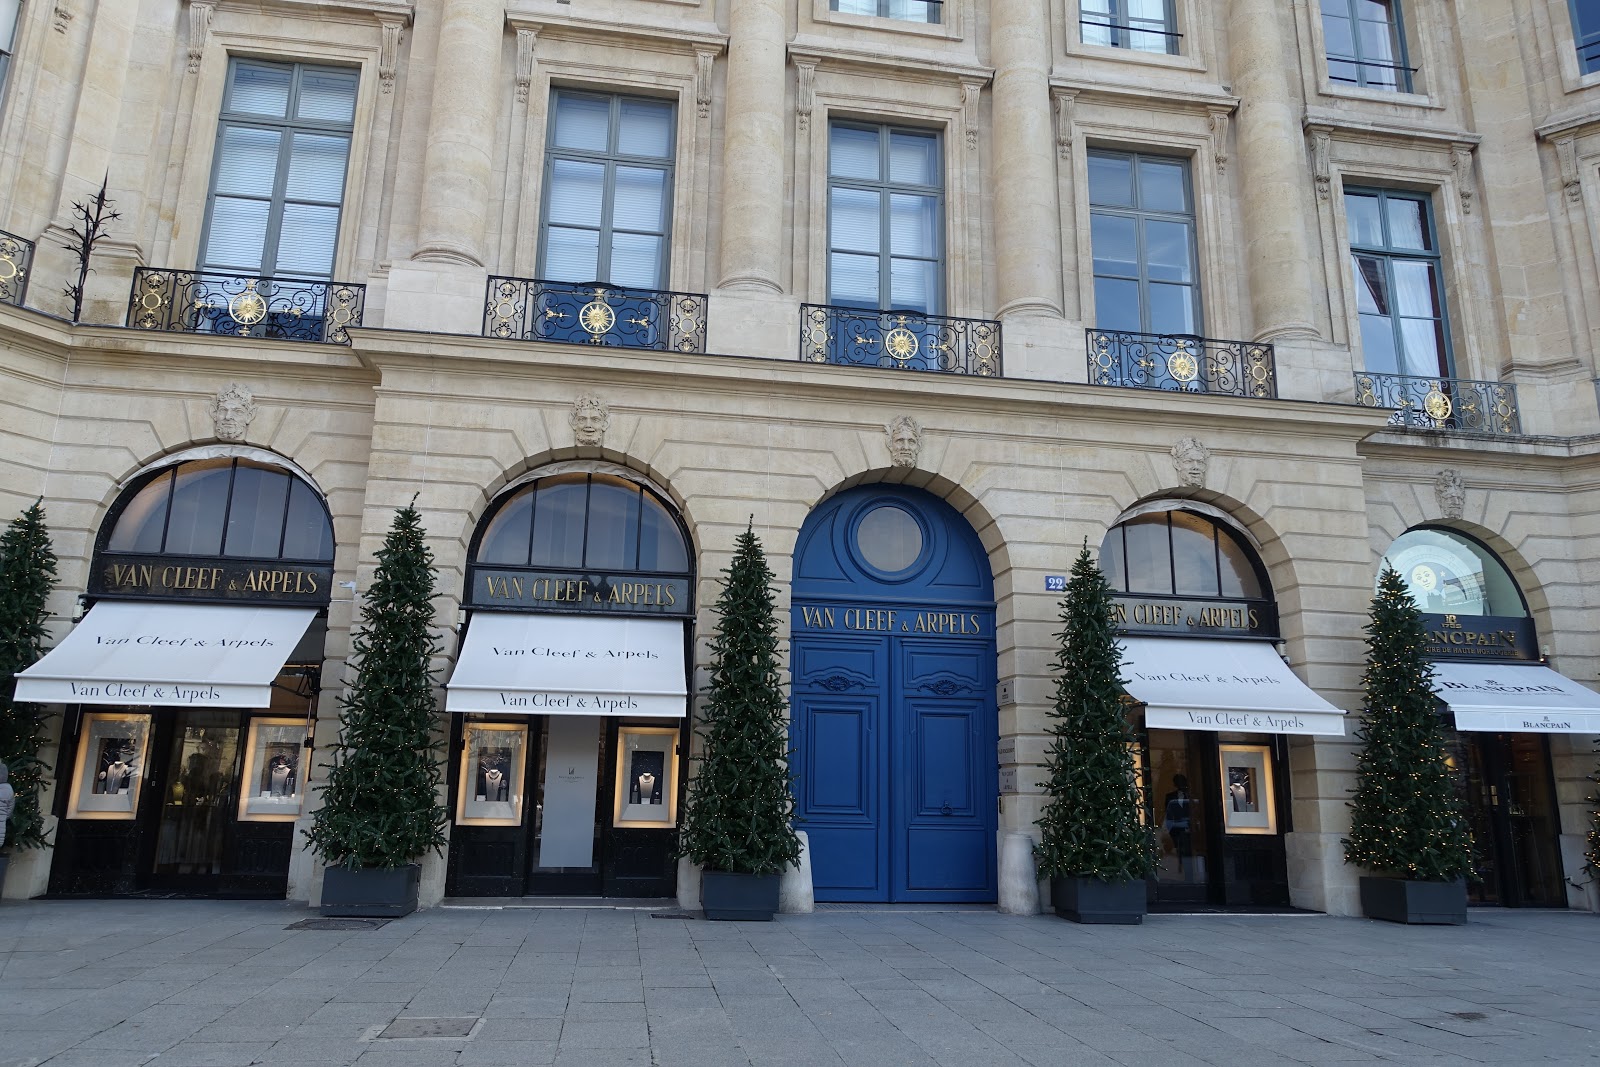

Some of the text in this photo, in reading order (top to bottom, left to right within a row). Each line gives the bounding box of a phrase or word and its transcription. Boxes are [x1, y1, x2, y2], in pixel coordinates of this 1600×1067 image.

[113, 564, 319, 594] VAN CLEEF & ARPELS
[1048, 578, 1064, 590] 22
[487, 576, 676, 607] VAN CLEEF & ARPELS
[801, 606, 981, 635] VAN CLEEF & ARPELS
[1107, 603, 1259, 629] AN CLEEF & ARPELS
[95, 635, 130, 646] Van
[136, 635, 194, 647] Cleef
[215, 637, 274, 649] Arpels
[493, 647, 525, 656] Van
[531, 647, 581, 658] Cleef
[602, 649, 659, 660] Arpels
[1135, 672, 1167, 682] Van
[1169, 672, 1211, 682] Cleef
[1232, 674, 1281, 686] Arpels
[1440, 681, 1565, 693] BLANCPAIN
[69, 682, 220, 703] Van Cleef & Arpels
[499, 692, 638, 712] Van Cleef & Arpels
[1188, 711, 1304, 730] Van Cleef & Arpels
[1523, 721, 1571, 729] BLANCPAIN
